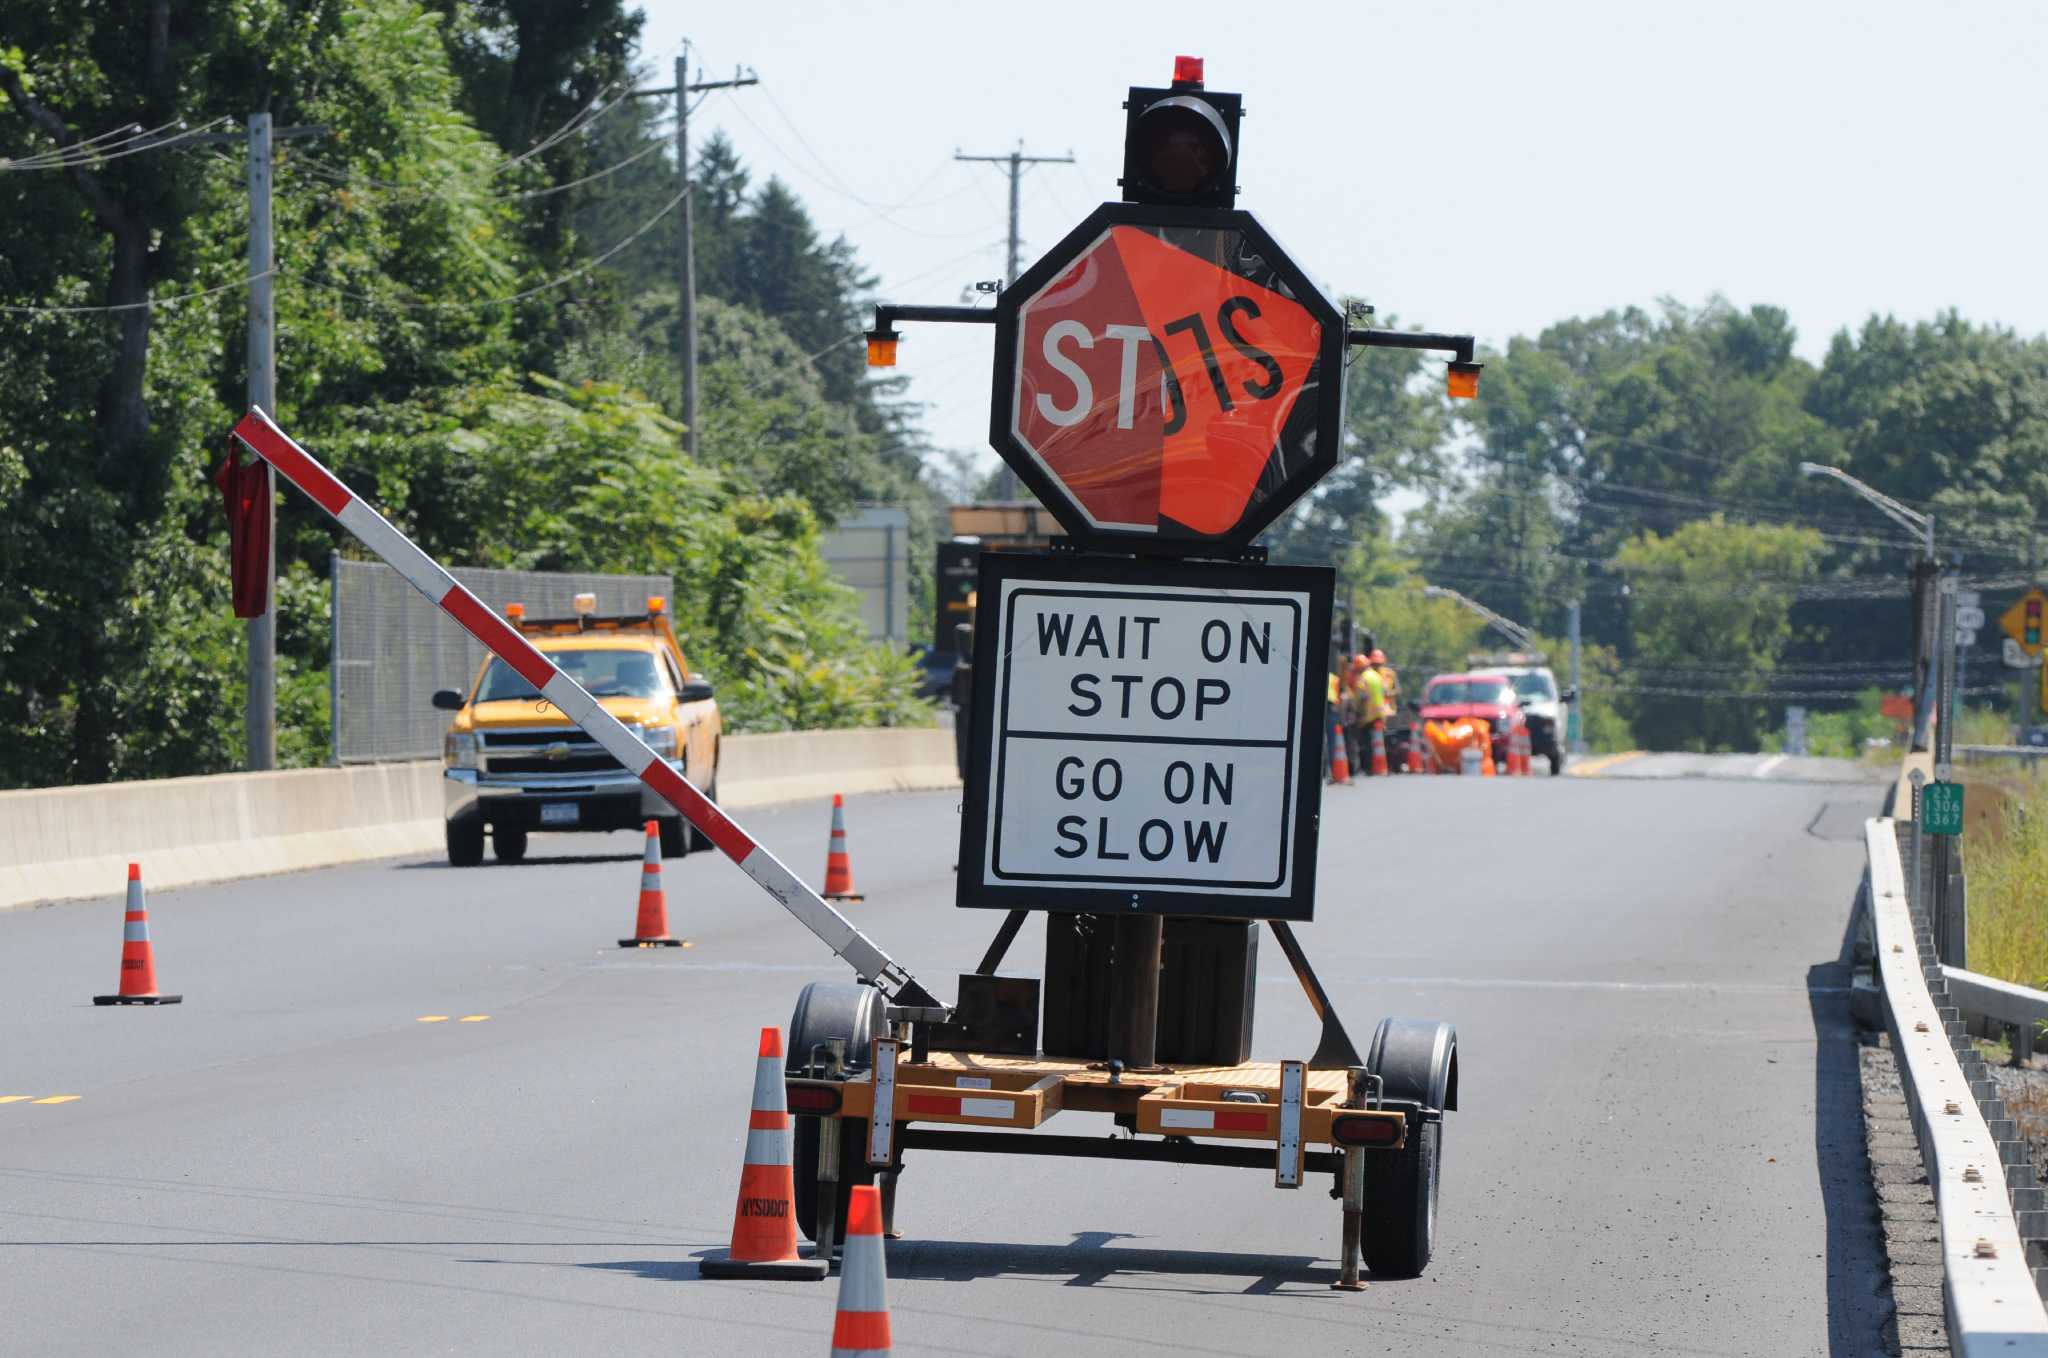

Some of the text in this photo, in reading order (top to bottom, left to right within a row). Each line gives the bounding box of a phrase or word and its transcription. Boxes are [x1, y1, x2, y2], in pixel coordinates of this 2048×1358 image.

[1036, 319, 1167, 430] ST
[1036, 612, 1271, 665] WAIT ON
[1067, 673, 1231, 722] STOP
[1055, 756, 1234, 806] GO ON
[1933, 786, 1951, 800] 23
[1053, 815, 1228, 864] SLOW
[1926, 812, 1960, 825] 1367
